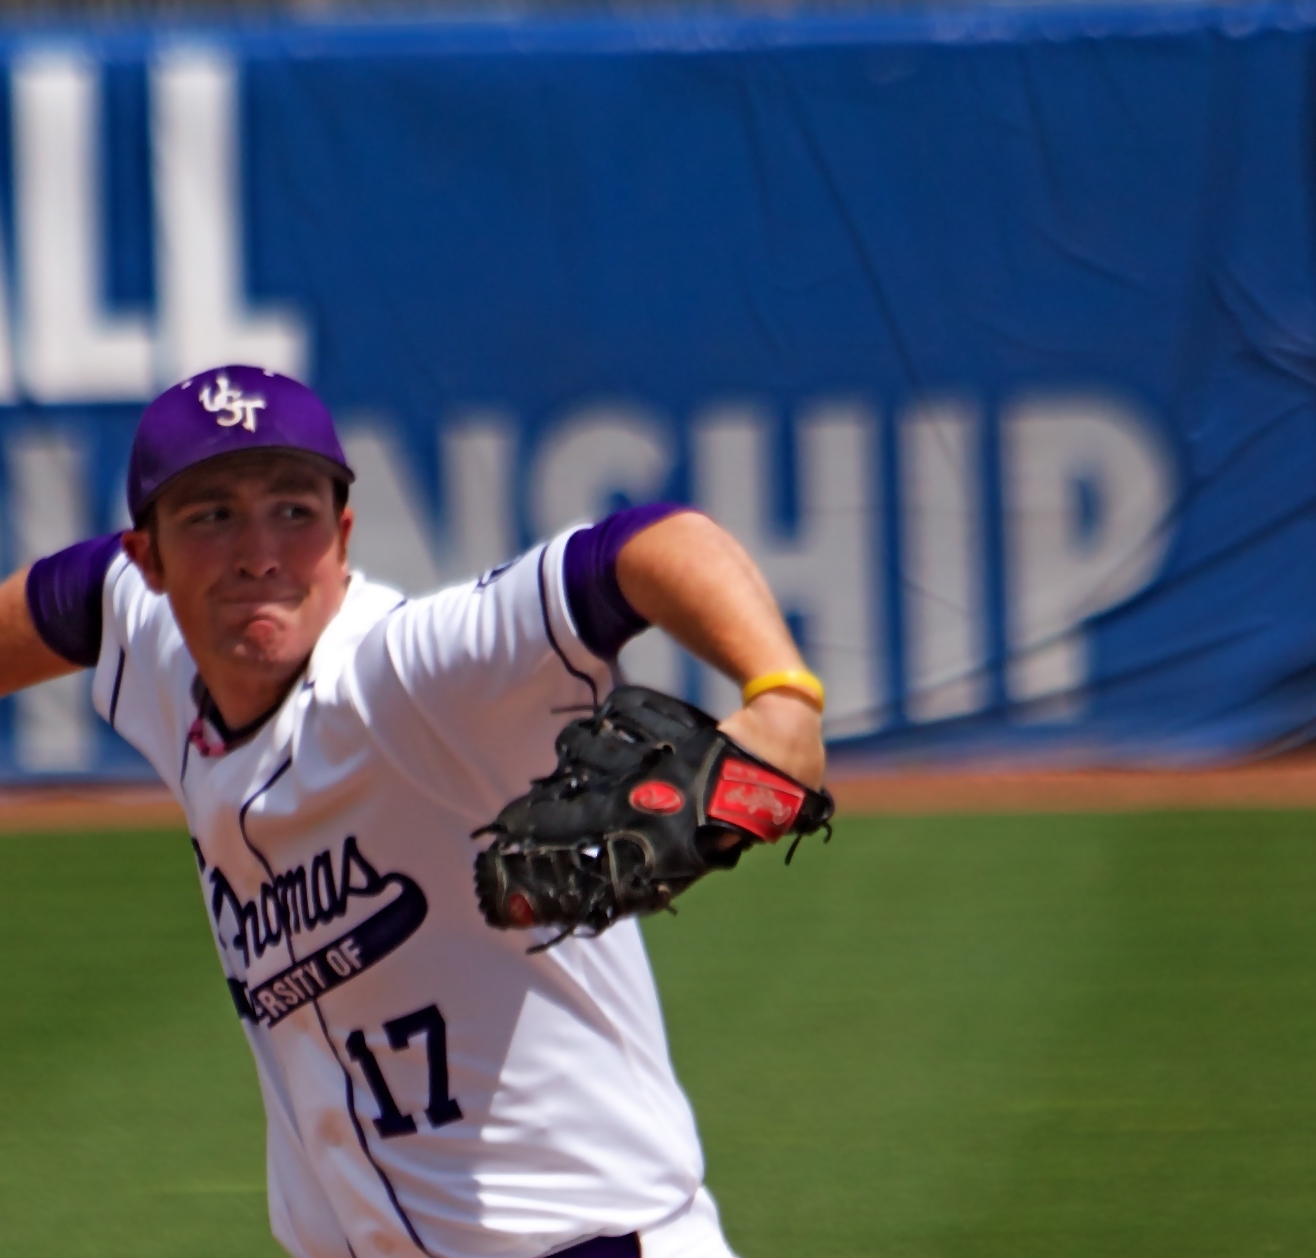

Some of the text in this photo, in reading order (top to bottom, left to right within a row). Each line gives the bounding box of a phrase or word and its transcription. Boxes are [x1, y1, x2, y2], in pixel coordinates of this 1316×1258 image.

[255, 937, 364, 1022] RSITY OF
[345, 1003, 464, 1140] 17
